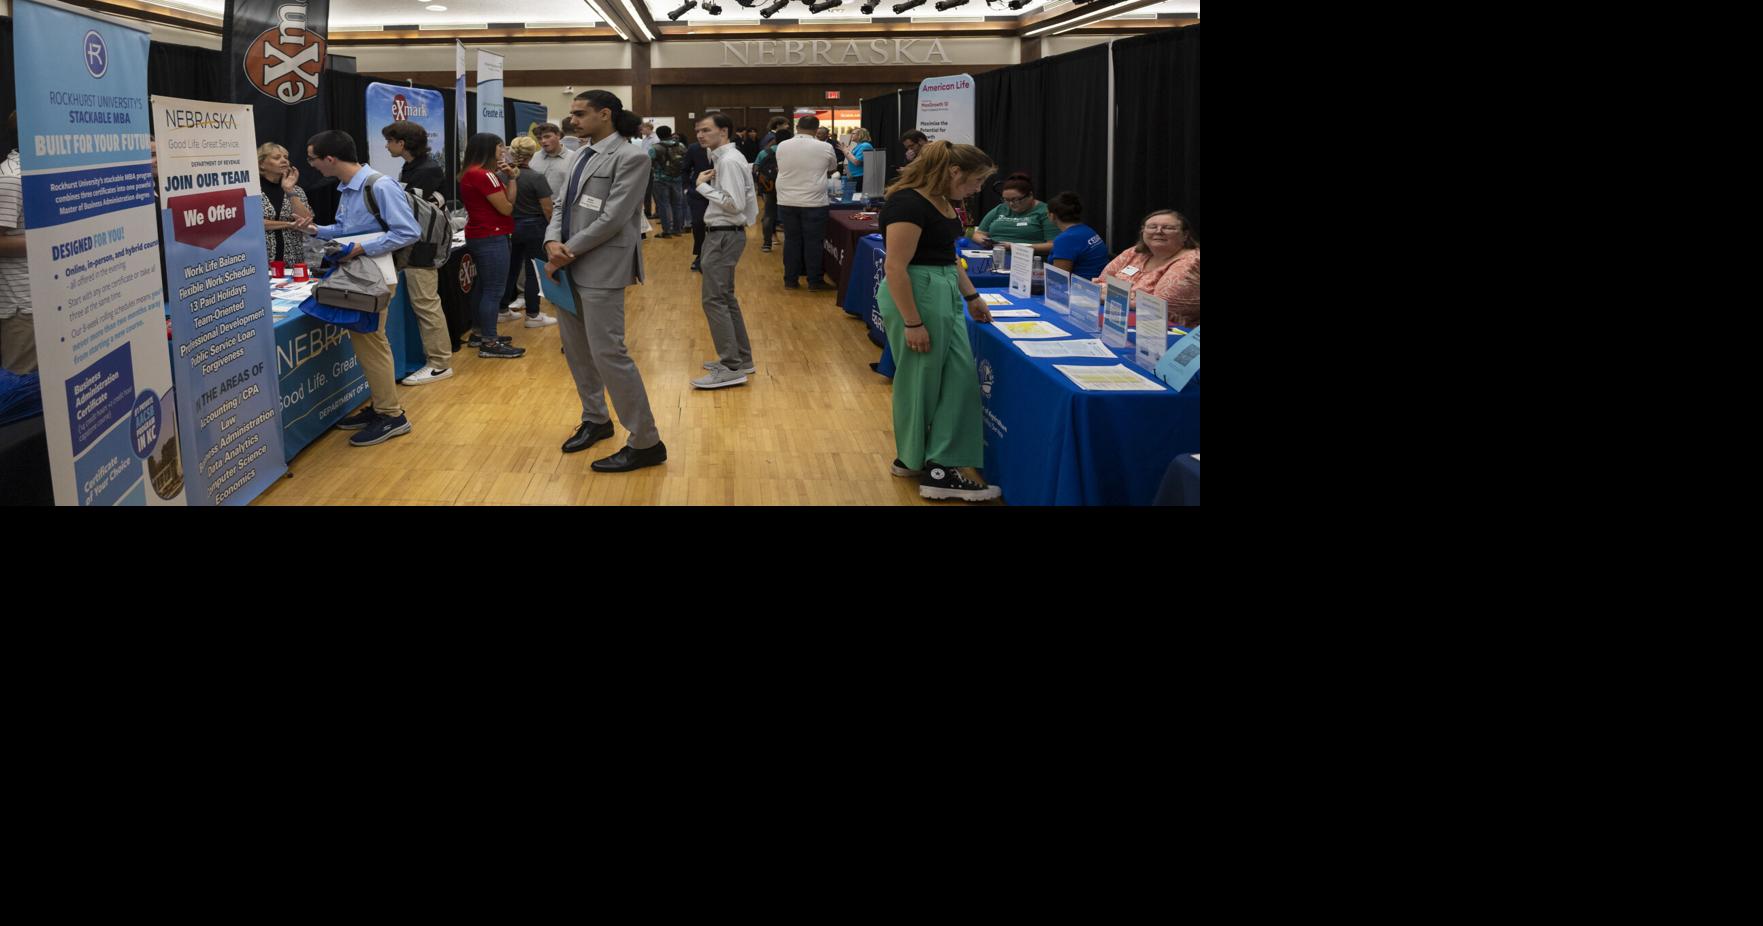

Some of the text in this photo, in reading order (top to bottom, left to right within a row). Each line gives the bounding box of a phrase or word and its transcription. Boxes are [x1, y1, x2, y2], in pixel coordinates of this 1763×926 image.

[721, 38, 952, 66] NEBRASKA
[922, 80, 969, 92] American Life
[50, 91, 142, 110] ROCKHURST UNIVERSITY'S
[392, 100, 428, 120] eXmark
[70, 110, 131, 124] STACKABLE MBA
[166, 109, 237, 130] NEBRASKA
[35, 134, 72, 156] BUILT
[73, 134, 94, 154] FOR
[94, 134, 120, 152] YOUR
[168, 140, 186, 149] Good
[202, 140, 218, 148] Great
[50, 182, 78, 192] Rockhurst
[79, 177, 103, 187] University's
[165, 170, 250, 192] JOIN OUR TEAM
[56, 193, 80, 203] combines
[93, 188, 116, 197] certificates
[60, 206, 77, 214] Master
[84, 200, 102, 211] Business
[103, 194, 135, 205] Administration
[184, 204, 237, 227] We Offer
[52, 227, 124, 261] DESIGNED FOR YOU!
[65, 264, 87, 277] Online,
[88, 254, 114, 268] in-person,
[115, 248, 124, 258] and
[125, 243, 143, 256] hybrid
[184, 253, 246, 278] Work Life Balance
[68, 295, 81, 308] Start
[82, 291, 92, 301] with
[93, 287, 101, 297] any
[102, 284, 111, 293] one
[111, 274, 133, 288] certificate
[140, 267, 150, 276] take
[180, 282, 203, 300] Flexible
[205, 277, 224, 289] Work
[224, 265, 256, 282] Schedule
[69, 310, 83, 321] three
[98, 297, 110, 307] same
[111, 292, 121, 300] time
[190, 285, 247, 312] 13 Paid Holidays
[90, 329, 103, 340] more
[104, 322, 117, 333] than
[117, 317, 127, 325] two
[128, 307, 147, 320] months
[193, 300, 245, 328] Team-Oriented
[71, 328, 82, 338] Our
[180, 309, 265, 356] Professional Development
[210, 337, 237, 356] Service
[238, 329, 256, 342] Loan
[74, 352, 89, 365] from
[114, 329, 126, 339] new
[202, 348, 244, 375] Forgiveness
[308, 372, 328, 394] Life.
[333, 354, 357, 377] Great
[74, 372, 101, 395] Business
[76, 371, 119, 408] Administration
[201, 387, 218, 406] THE
[220, 369, 250, 395] AREAS
[252, 362, 264, 376] OF
[242, 384, 259, 399] CPA
[77, 392, 108, 420] Certificate
[320, 389, 356, 420] DEPARTMENT
[356, 384, 364, 394] OF
[220, 409, 274, 448] Administration
[221, 416, 236, 431] Law
[137, 425, 156, 453] IN KC
[208, 434, 258, 478] Data Analytics
[238, 444, 267, 470] Science
[84, 456, 118, 493] Certificate
[86, 458, 130, 506] of Your Choice
[216, 468, 256, 505] Economics
